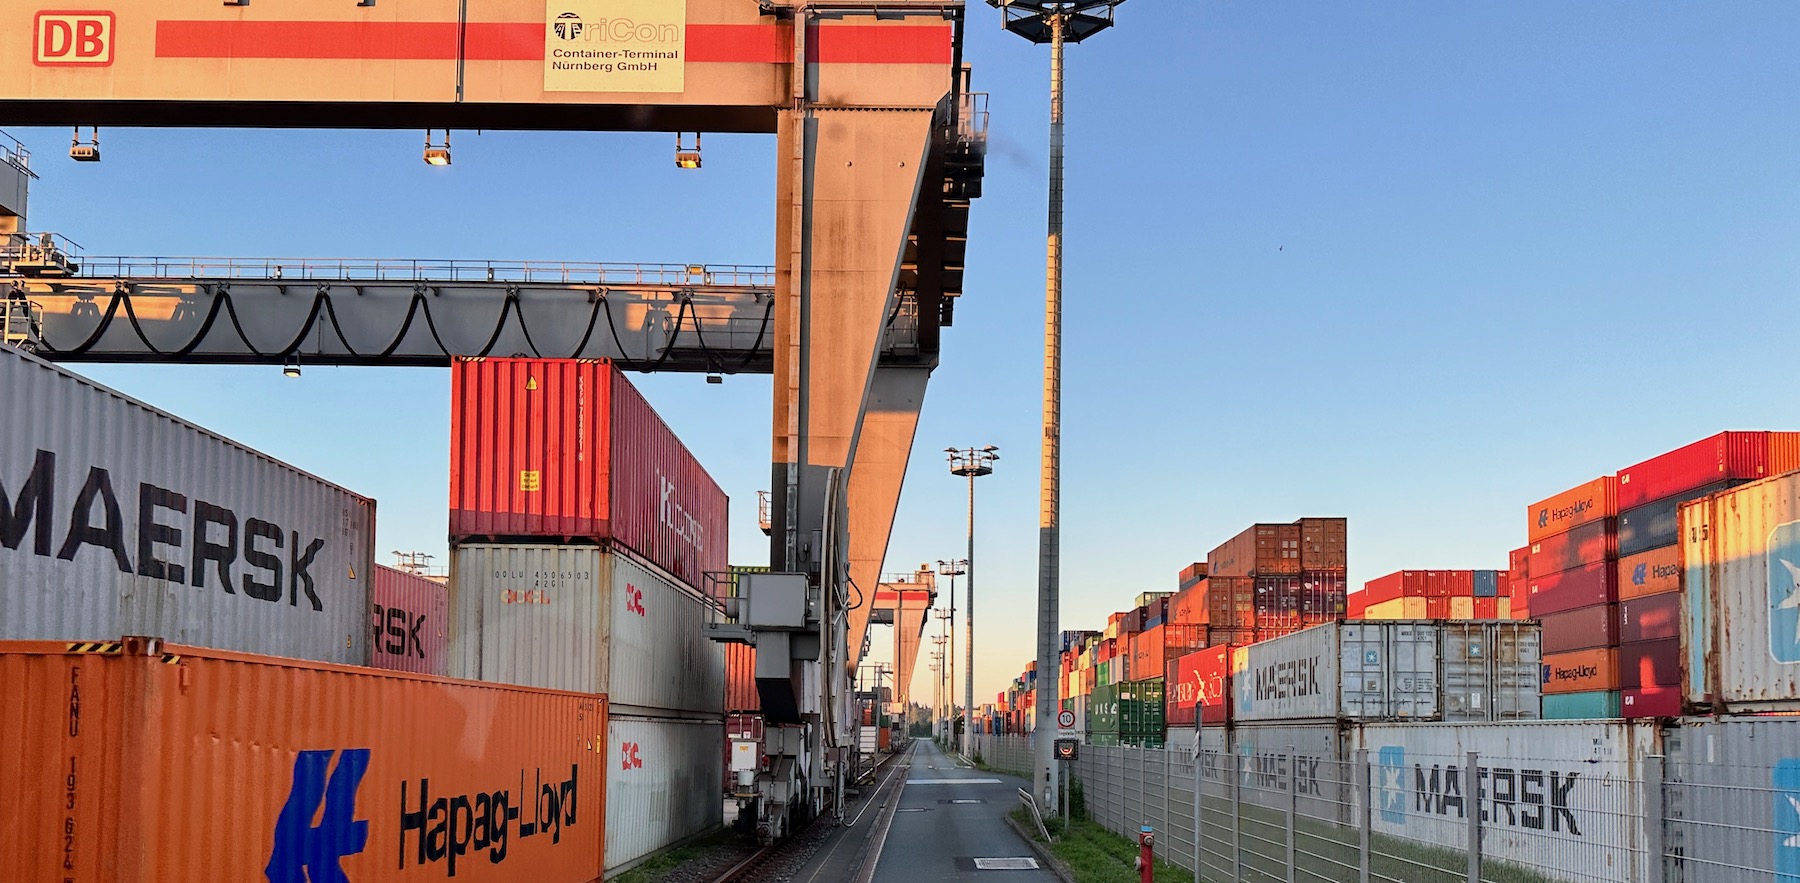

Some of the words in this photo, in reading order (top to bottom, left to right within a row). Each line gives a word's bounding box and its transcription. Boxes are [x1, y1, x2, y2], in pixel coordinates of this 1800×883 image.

[43, 20, 104, 57] DB
[553, 49, 678, 59] Container-Terminal
[552, 61, 613, 73] Nürnberg
[617, 61, 657, 71] GmbH
[1552, 496, 1593, 522] Hapag-Lloyd
[0, 449, 325, 612] MAERSK
[1256, 655, 1321, 701] MAERSK
[1555, 664, 1597, 684] Hapag-Lloyd
[1062, 714, 1072, 724] 10
[1257, 752, 1322, 797] MAESK
[399, 764, 578, 877] Hapag-Lloyd
